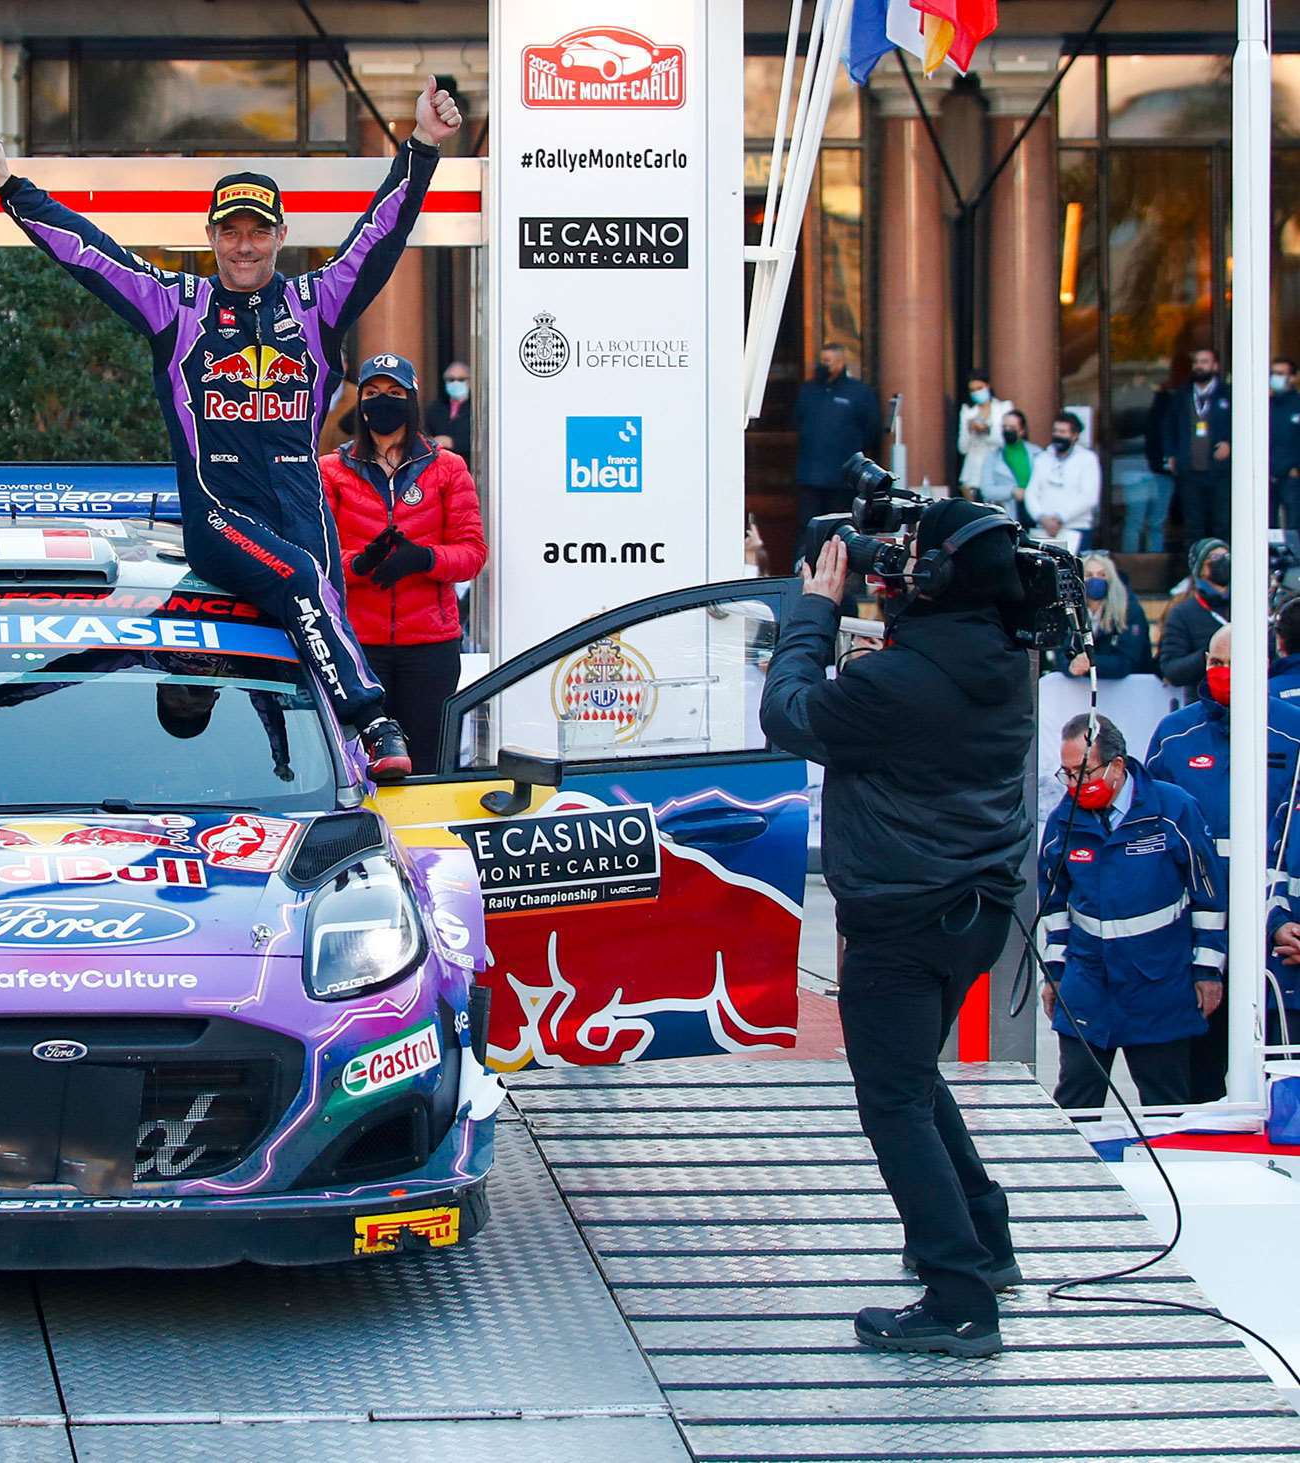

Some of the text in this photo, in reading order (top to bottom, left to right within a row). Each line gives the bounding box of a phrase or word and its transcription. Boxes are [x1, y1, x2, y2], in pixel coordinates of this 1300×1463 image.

[528, 54, 558, 76] 2022
[651, 55, 679, 76] 2022
[528, 67, 679, 101] RALLYE MONTE-CARLO
[520, 148, 688, 173] #RallyeMonteCarlo
[523, 222, 684, 247] LE CASINO
[586, 340, 690, 354] LA BOUTIQUE
[586, 354, 690, 368] OFFICIELLE
[203, 389, 309, 421] Red Bull
[607, 455, 638, 465] france
[570, 458, 638, 489] bleu
[64, 482, 74, 493] by
[543, 542, 666, 564] acm.mc
[501, 815, 648, 859] CASINO
[57, 856, 208, 889] Bull
[488, 895, 517, 909] Rally
[519, 889, 598, 906] Championship
[43, 1044, 77, 1060] Ford
[368, 1032, 438, 1084] Castrol
